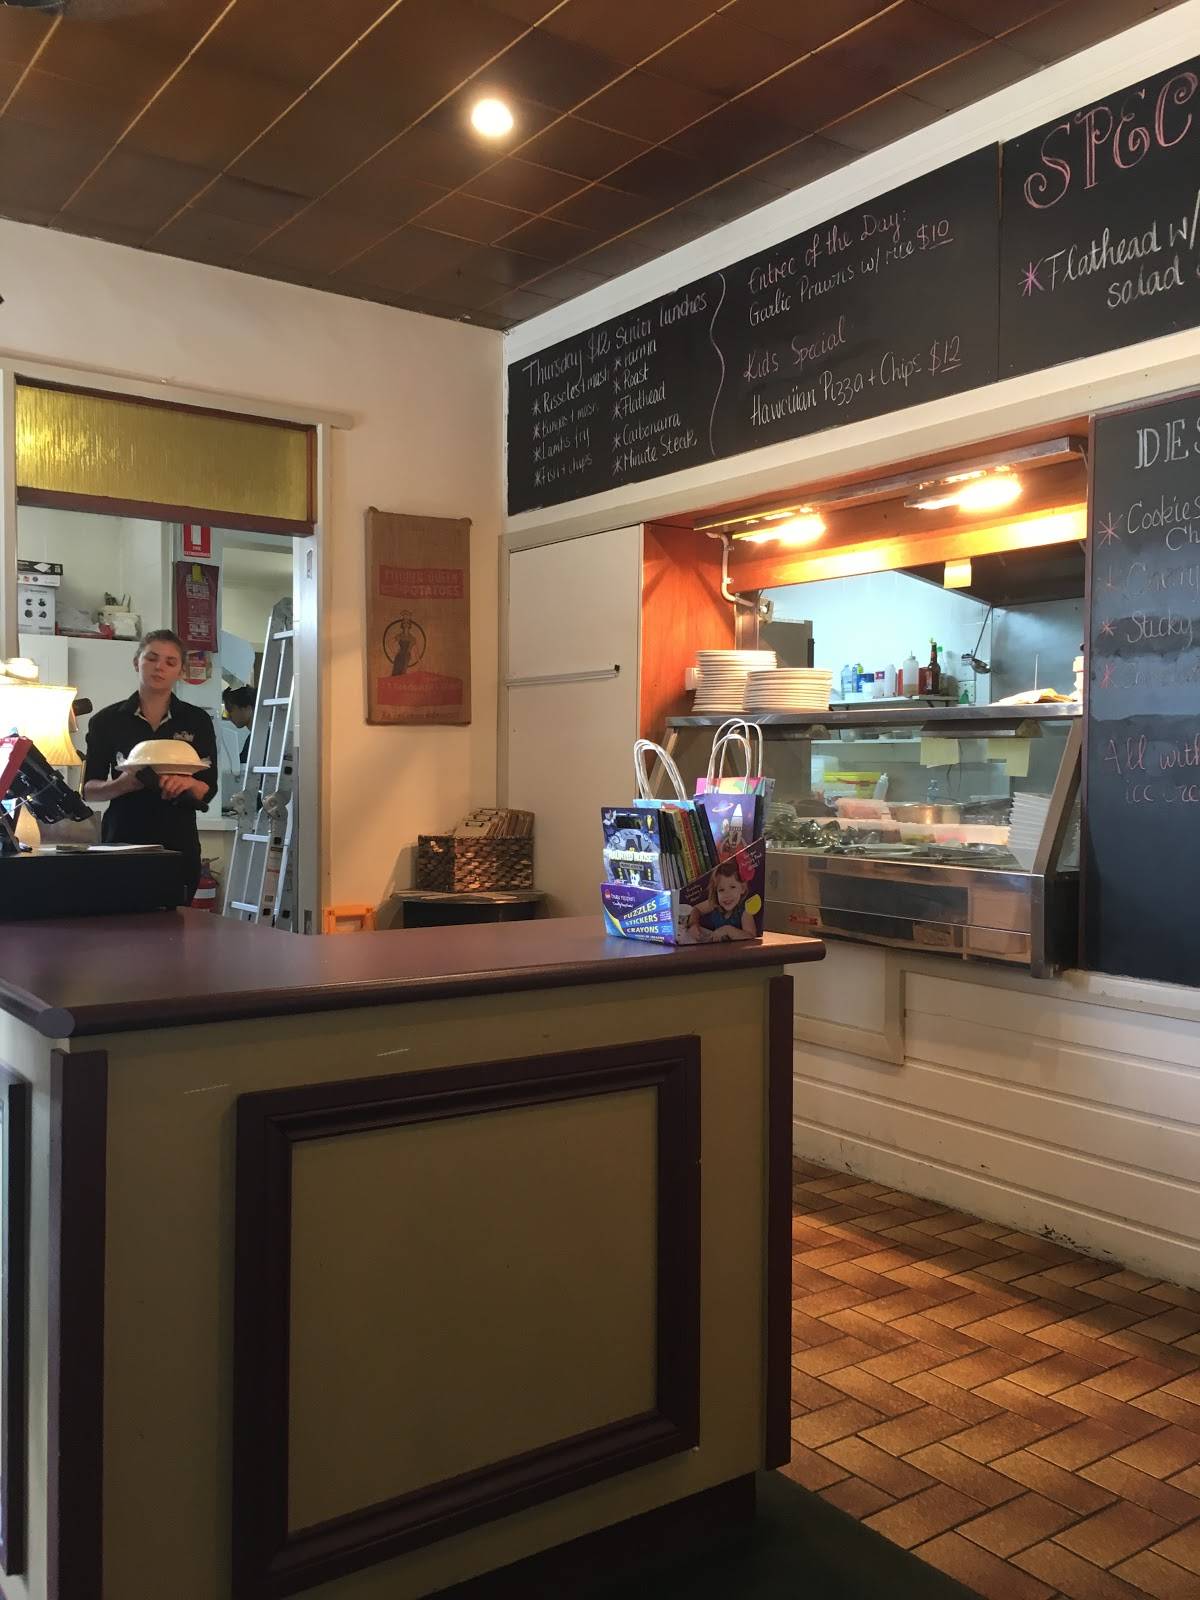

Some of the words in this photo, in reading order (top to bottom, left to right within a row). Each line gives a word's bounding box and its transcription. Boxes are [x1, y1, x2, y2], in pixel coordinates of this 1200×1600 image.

[804, 234, 823, 268] of
[826, 225, 853, 252] the
[1044, 219, 1162, 291] Flathead
[749, 289, 791, 327] Garlic
[800, 268, 854, 303] Prawns
[886, 241, 914, 265] rice
[916, 219, 950, 250] $10
[522, 350, 583, 387] Thursday
[587, 331, 610, 363] $12
[743, 351, 779, 382] Kids
[791, 315, 847, 371] Special
[624, 360, 649, 390] Roast
[819, 370, 864, 406] Pizza
[880, 352, 921, 387] Chips
[928, 336, 961, 376] $12
[620, 380, 667, 416] Flathead
[1127, 608, 1193, 650] Sticky
[623, 900, 657, 920] PUZZLES
[625, 914, 658, 926] STICKERS
[626, 925, 659, 933] CRAYONS
